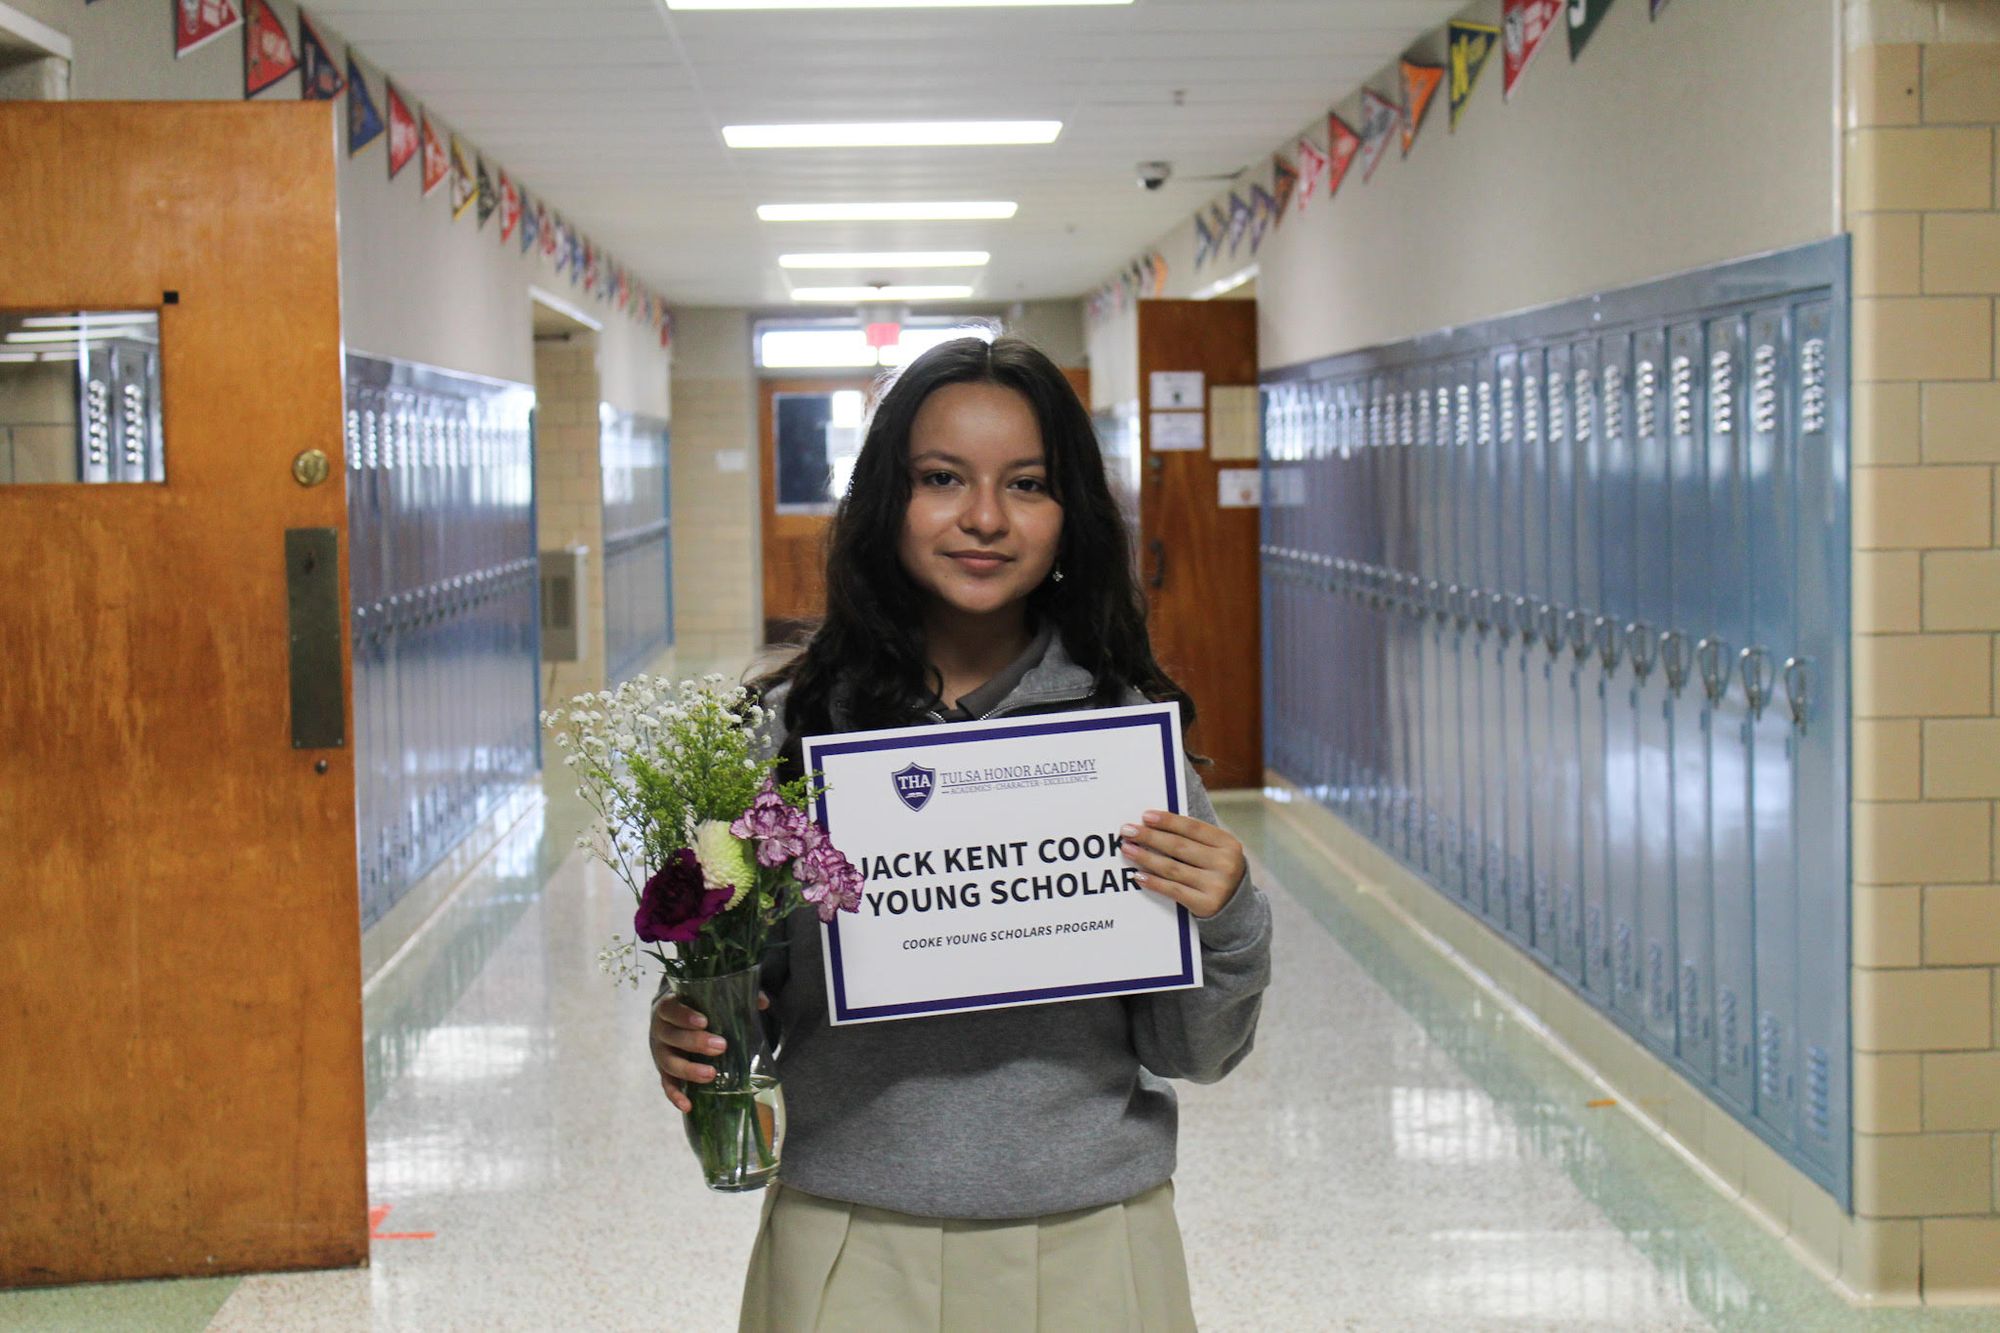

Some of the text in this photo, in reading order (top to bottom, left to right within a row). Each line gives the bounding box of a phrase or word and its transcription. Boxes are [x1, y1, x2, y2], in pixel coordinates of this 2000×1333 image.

[898, 774, 931, 790] THA
[940, 759, 1096, 785] TULSA HONOR ACADEMY
[861, 833, 1124, 881] JACK KENT COOK
[865, 867, 1142, 917] YOUNG SCHOLAR
[902, 919, 1115, 951] COOKE YOUNG SCHOLARS PROGRAM
